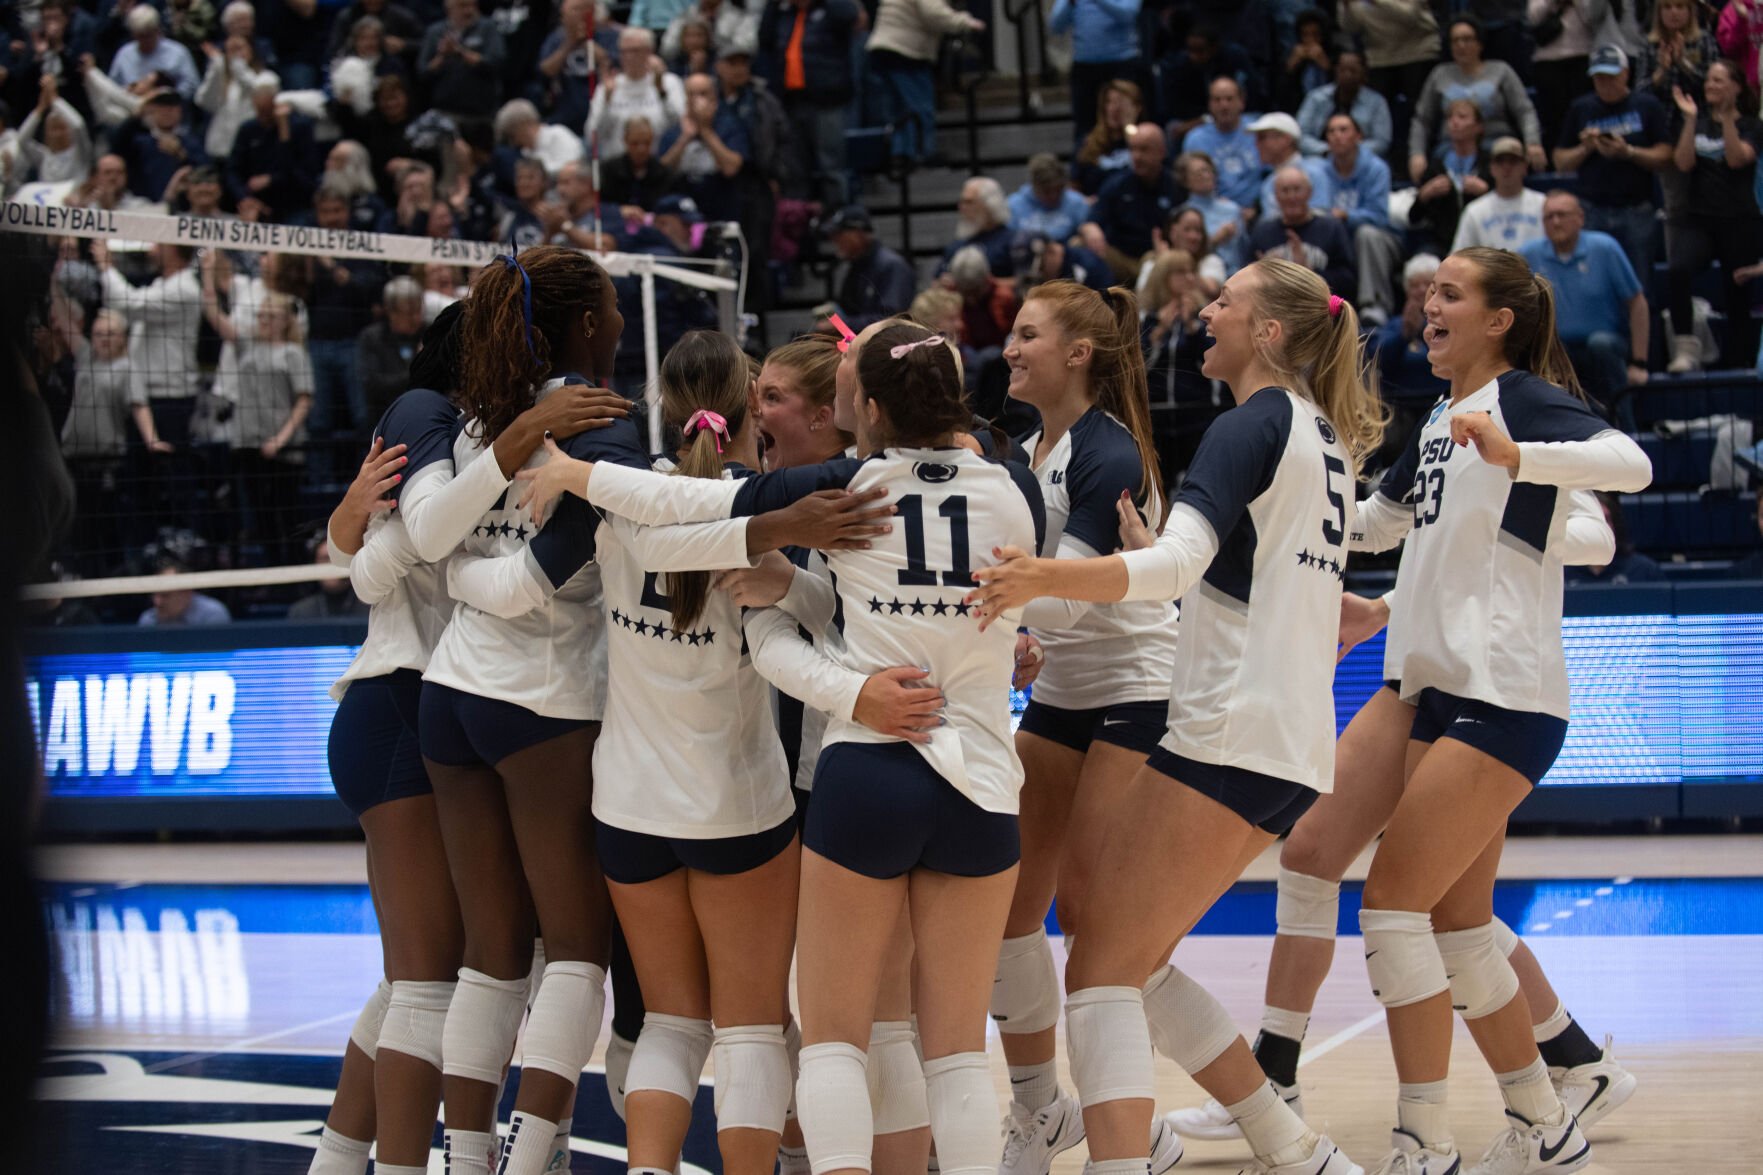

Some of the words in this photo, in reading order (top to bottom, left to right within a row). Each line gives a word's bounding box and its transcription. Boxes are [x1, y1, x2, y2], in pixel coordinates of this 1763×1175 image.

[177, 216, 225, 241] PENN
[230, 221, 281, 246] STATE
[286, 226, 385, 254] VOLLEYBALL
[431, 237, 469, 259] PENN
[1421, 437, 1456, 465] PSU
[1322, 452, 1346, 547] 5
[1413, 468, 1445, 529] 23
[893, 493, 981, 588] 11
